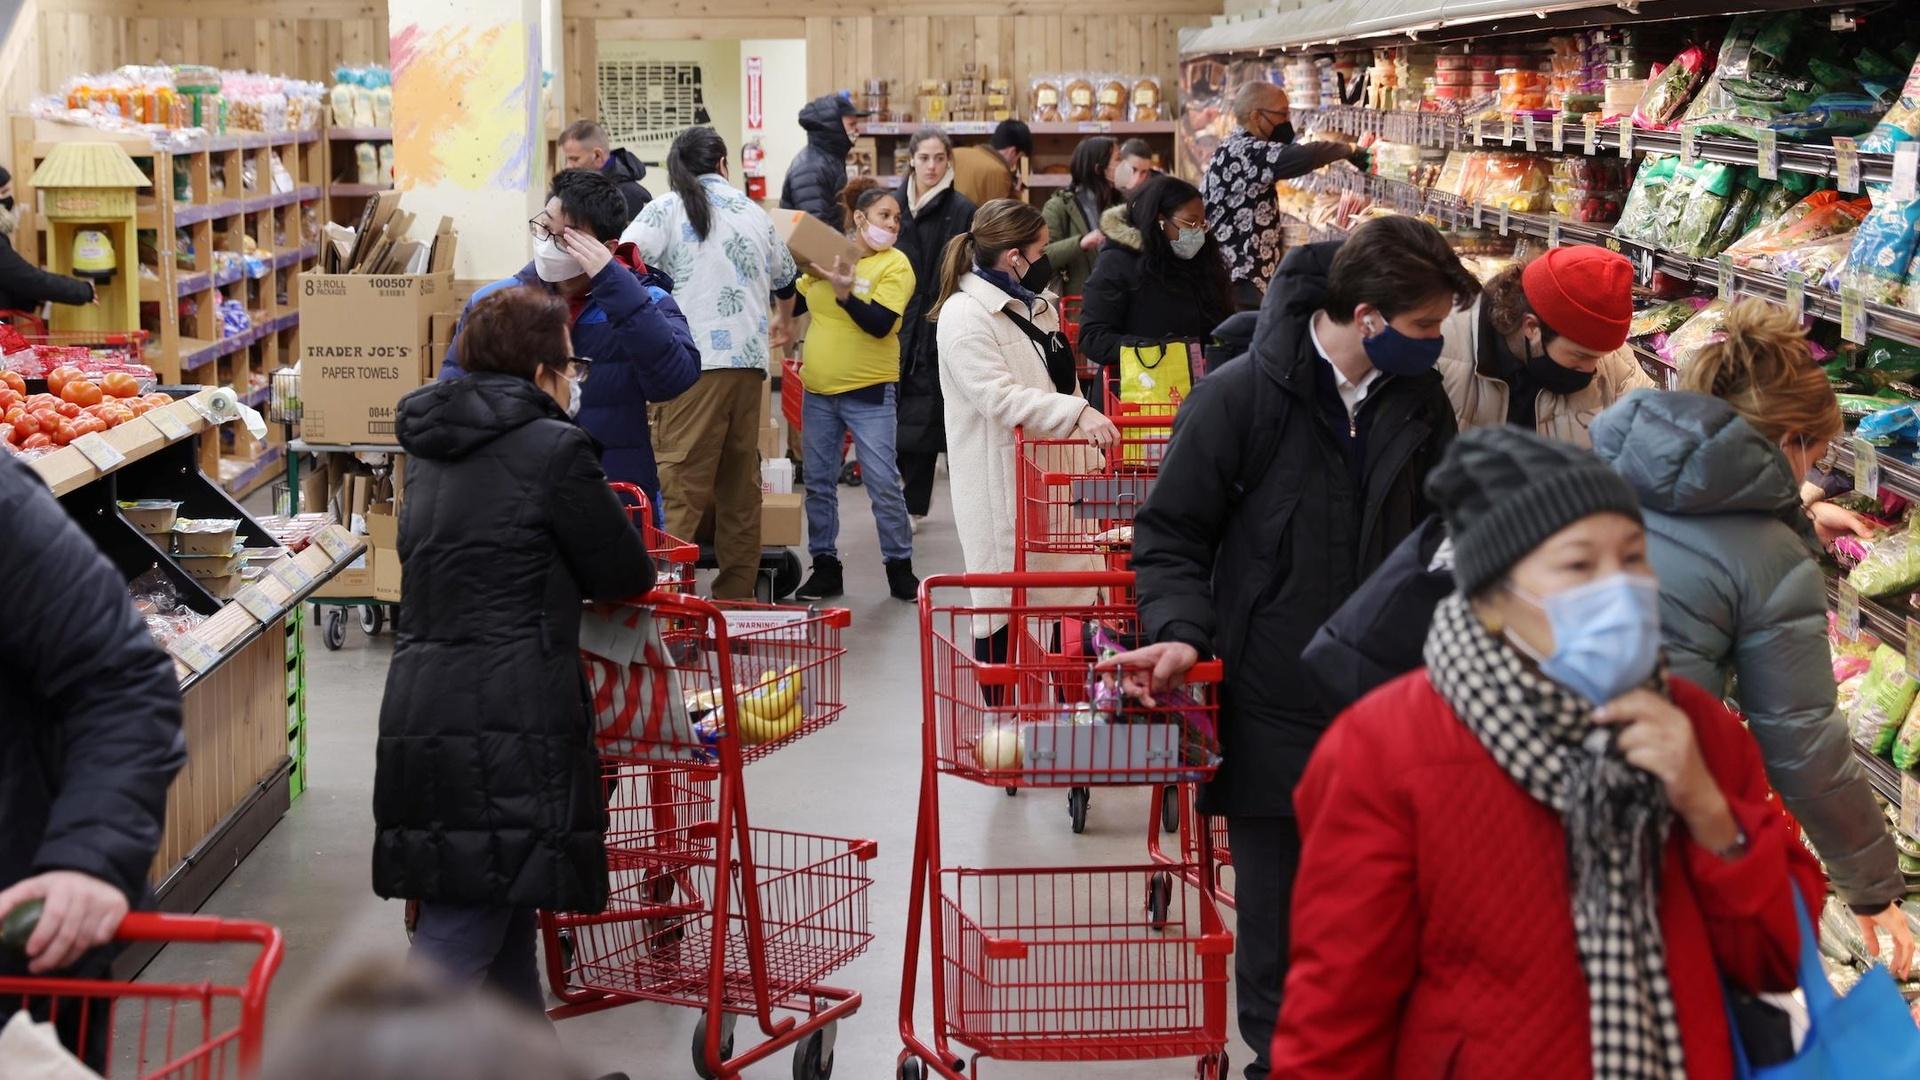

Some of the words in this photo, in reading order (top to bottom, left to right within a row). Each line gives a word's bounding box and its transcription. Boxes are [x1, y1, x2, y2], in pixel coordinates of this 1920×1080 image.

[305, 280, 315, 296] 8
[368, 279, 414, 289] 100507
[307, 346, 363, 358] TRADER
[321, 366, 356, 379] PAPER
[357, 366, 399, 379] TOWELS
